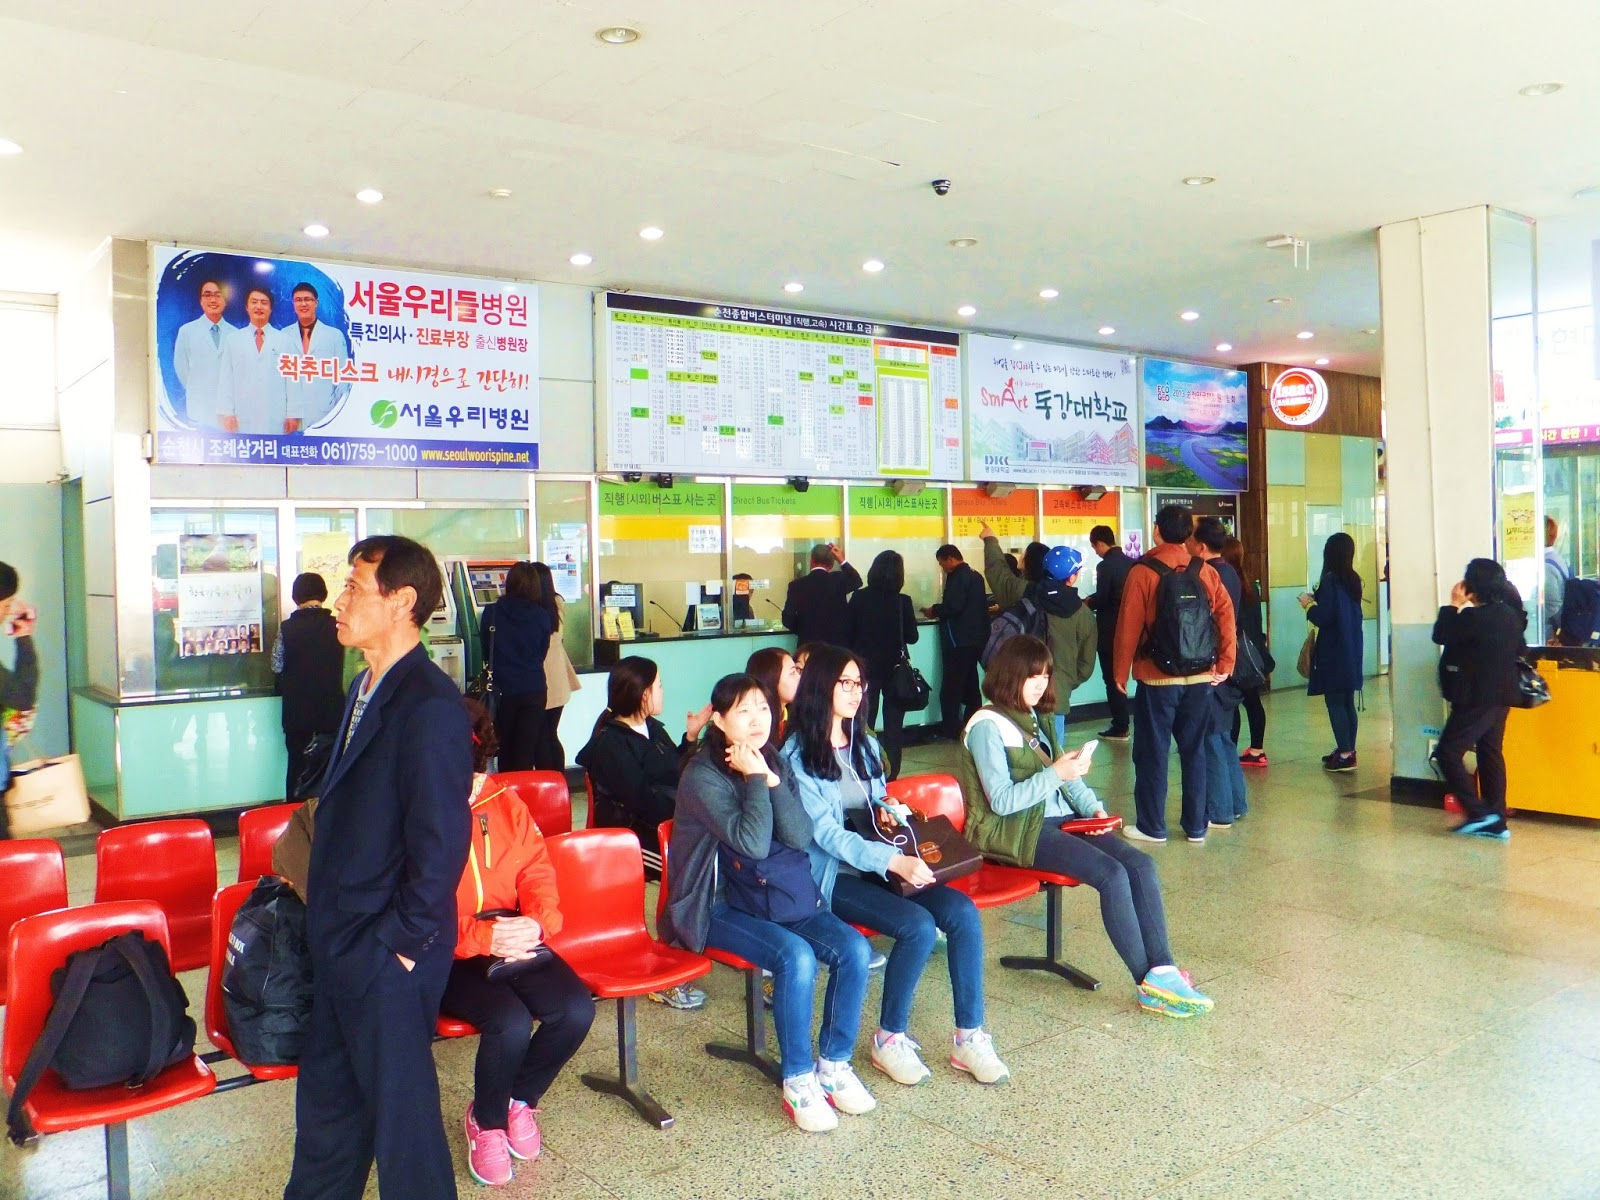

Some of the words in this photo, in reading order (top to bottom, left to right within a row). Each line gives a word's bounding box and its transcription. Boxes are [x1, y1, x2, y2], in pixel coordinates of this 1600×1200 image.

[349, 281, 527, 327] 서울우리들병원
[714, 306, 792, 326] 순천종합버스터미널
[416, 327, 470, 349] 진료부장
[280, 354, 379, 383] 척추디스크
[387, 365, 471, 389] 내시경으로
[476, 369, 529, 393] 간단히!
[1035, 389, 1128, 423] 동강대학교
[1157, 393, 1170, 402] GEO
[400, 404, 529, 431] 서울우리병원
[209, 438, 278, 460] 조례삼거리
[281, 444, 318, 459] 대표전화
[321, 441, 418, 462] 061)759-1000
[421, 447, 530, 466] www.seoulwoorispine.net
[707, 493, 717, 506] 곳
[733, 496, 755, 505] Direct
[756, 496, 770, 505] Bus
[771, 496, 796, 505] Tickets
